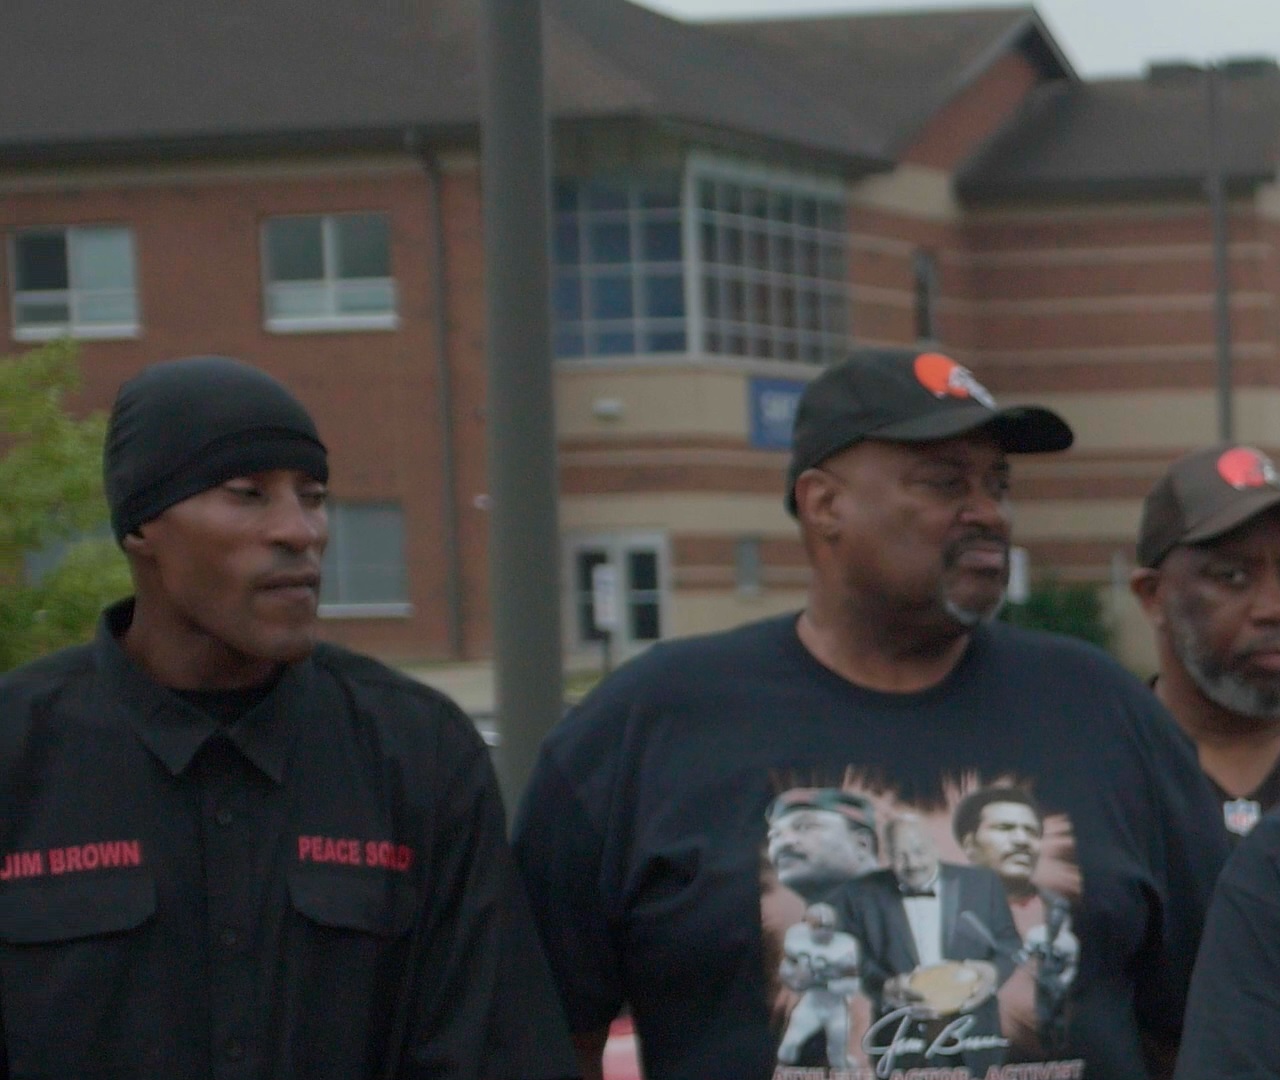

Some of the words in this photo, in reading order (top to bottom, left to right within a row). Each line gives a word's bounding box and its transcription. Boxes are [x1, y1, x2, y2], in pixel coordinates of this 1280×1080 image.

[0, 851, 42, 881] JIM
[48, 840, 141, 875] BROWN
[297, 835, 362, 867] PEACE
